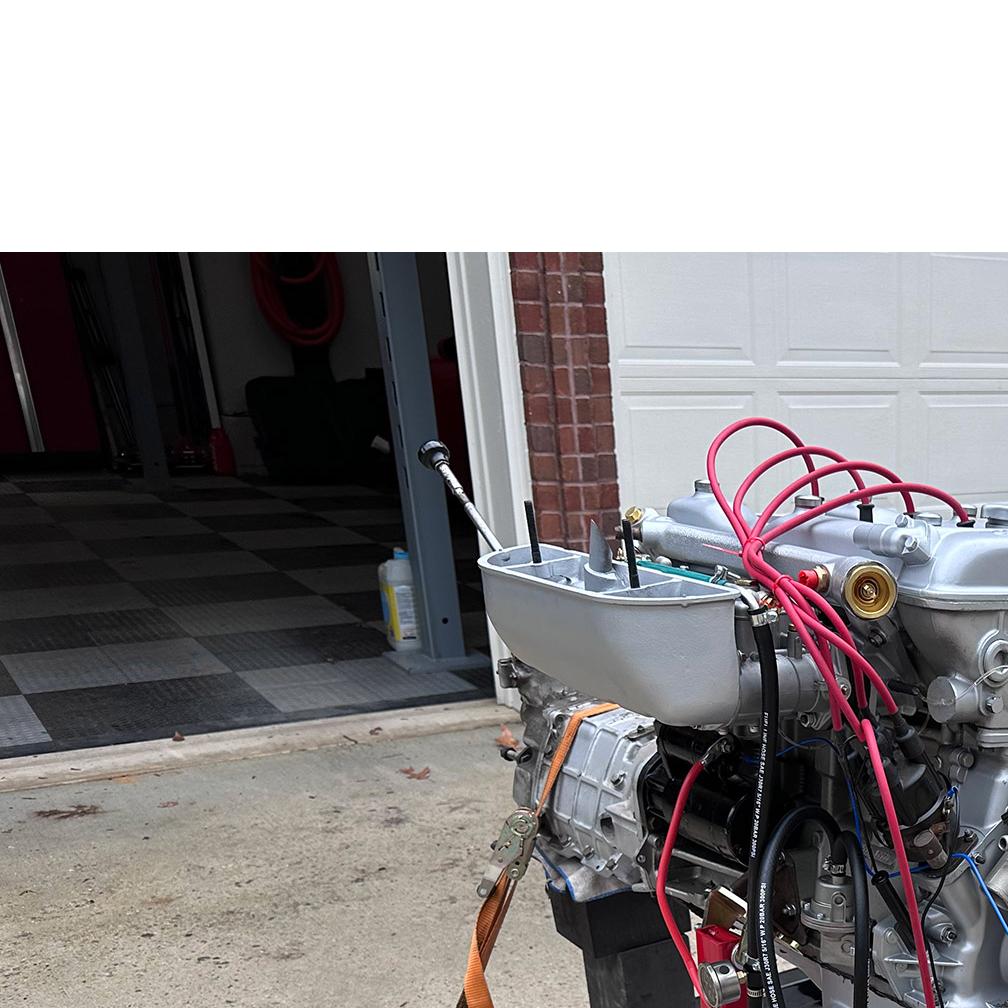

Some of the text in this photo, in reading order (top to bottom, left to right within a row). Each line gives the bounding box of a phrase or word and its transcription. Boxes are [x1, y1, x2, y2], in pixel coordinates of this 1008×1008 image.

[759, 882, 767, 903] 300PSI
[758, 903, 766, 924] 20BAR
[760, 936, 768, 953] 5/16"
[762, 953, 771, 972] J30R7
[765, 971, 774, 985] SAE
[768, 985, 778, 1003] HOSE
